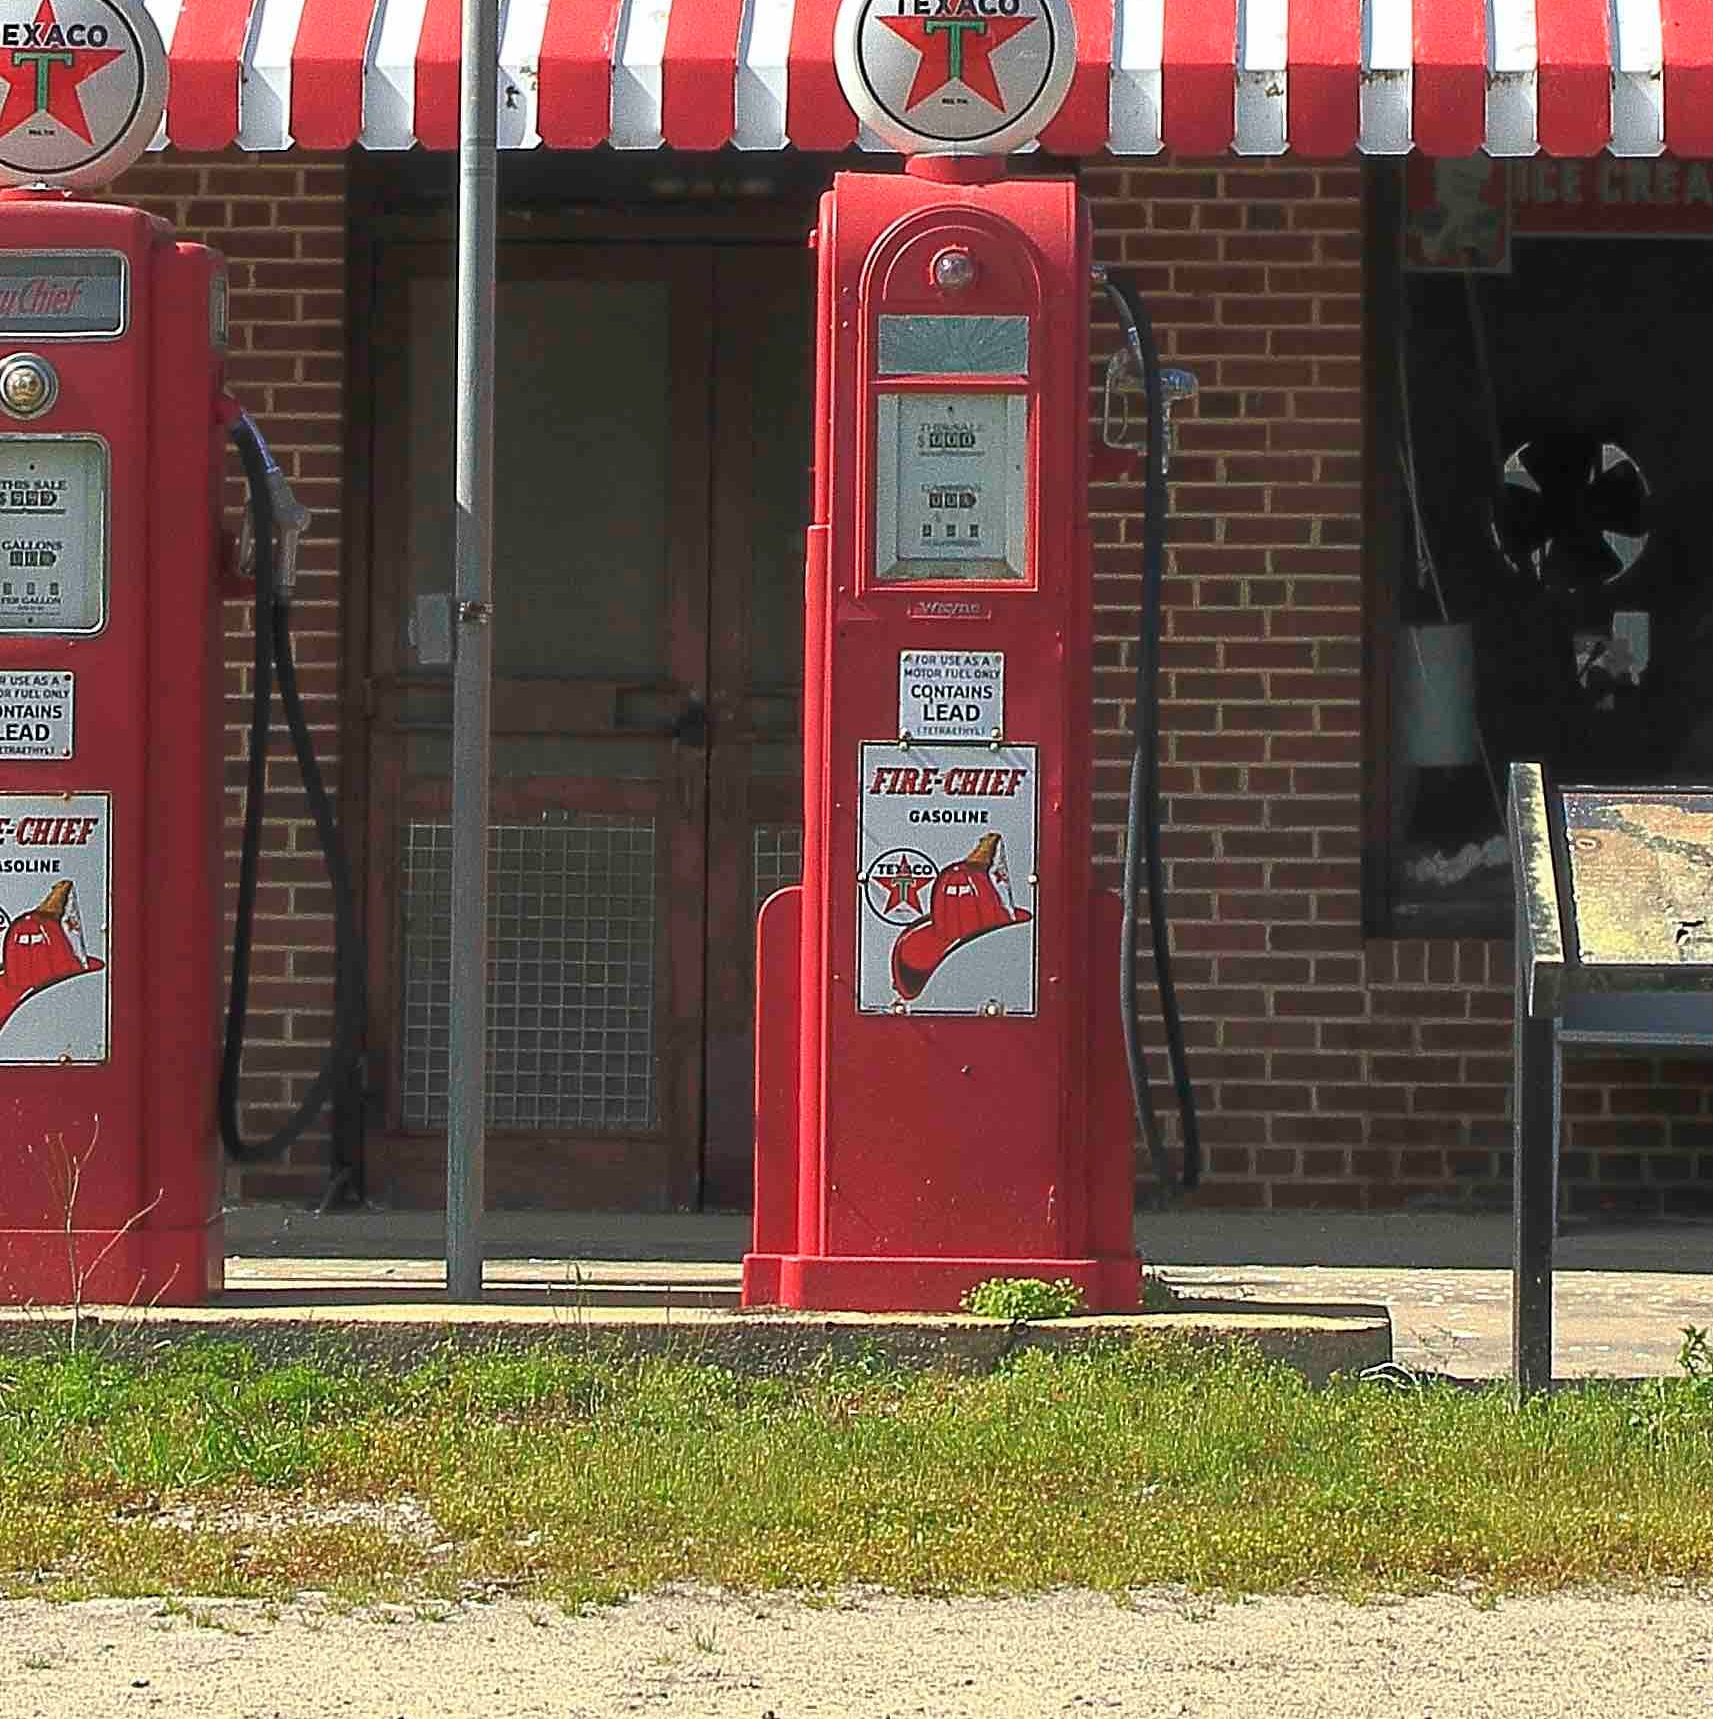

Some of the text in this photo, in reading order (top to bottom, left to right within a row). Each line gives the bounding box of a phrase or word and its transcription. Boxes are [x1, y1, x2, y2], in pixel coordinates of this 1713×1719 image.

[1, 540, 63, 551] GALLONS
[940, 655, 960, 665] USE
[964, 656, 978, 666] AS
[981, 656, 990, 666] A
[904, 668, 942, 678] MOTOR
[946, 669, 972, 679] FUEL
[10, 676, 31, 686] USE
[34, 676, 49, 686] AS
[51, 676, 60, 686] A
[15, 689, 41, 699] FUEL
[43, 688, 70, 699] ONLY
[911, 685, 993, 699] CONTAINS
[923, 704, 981, 722] LEAD
[869, 768, 1028, 796] FIRE-CHIEF
[909, 810, 989, 823] GASOLINE
[876, 864, 933, 875] TEXACO
